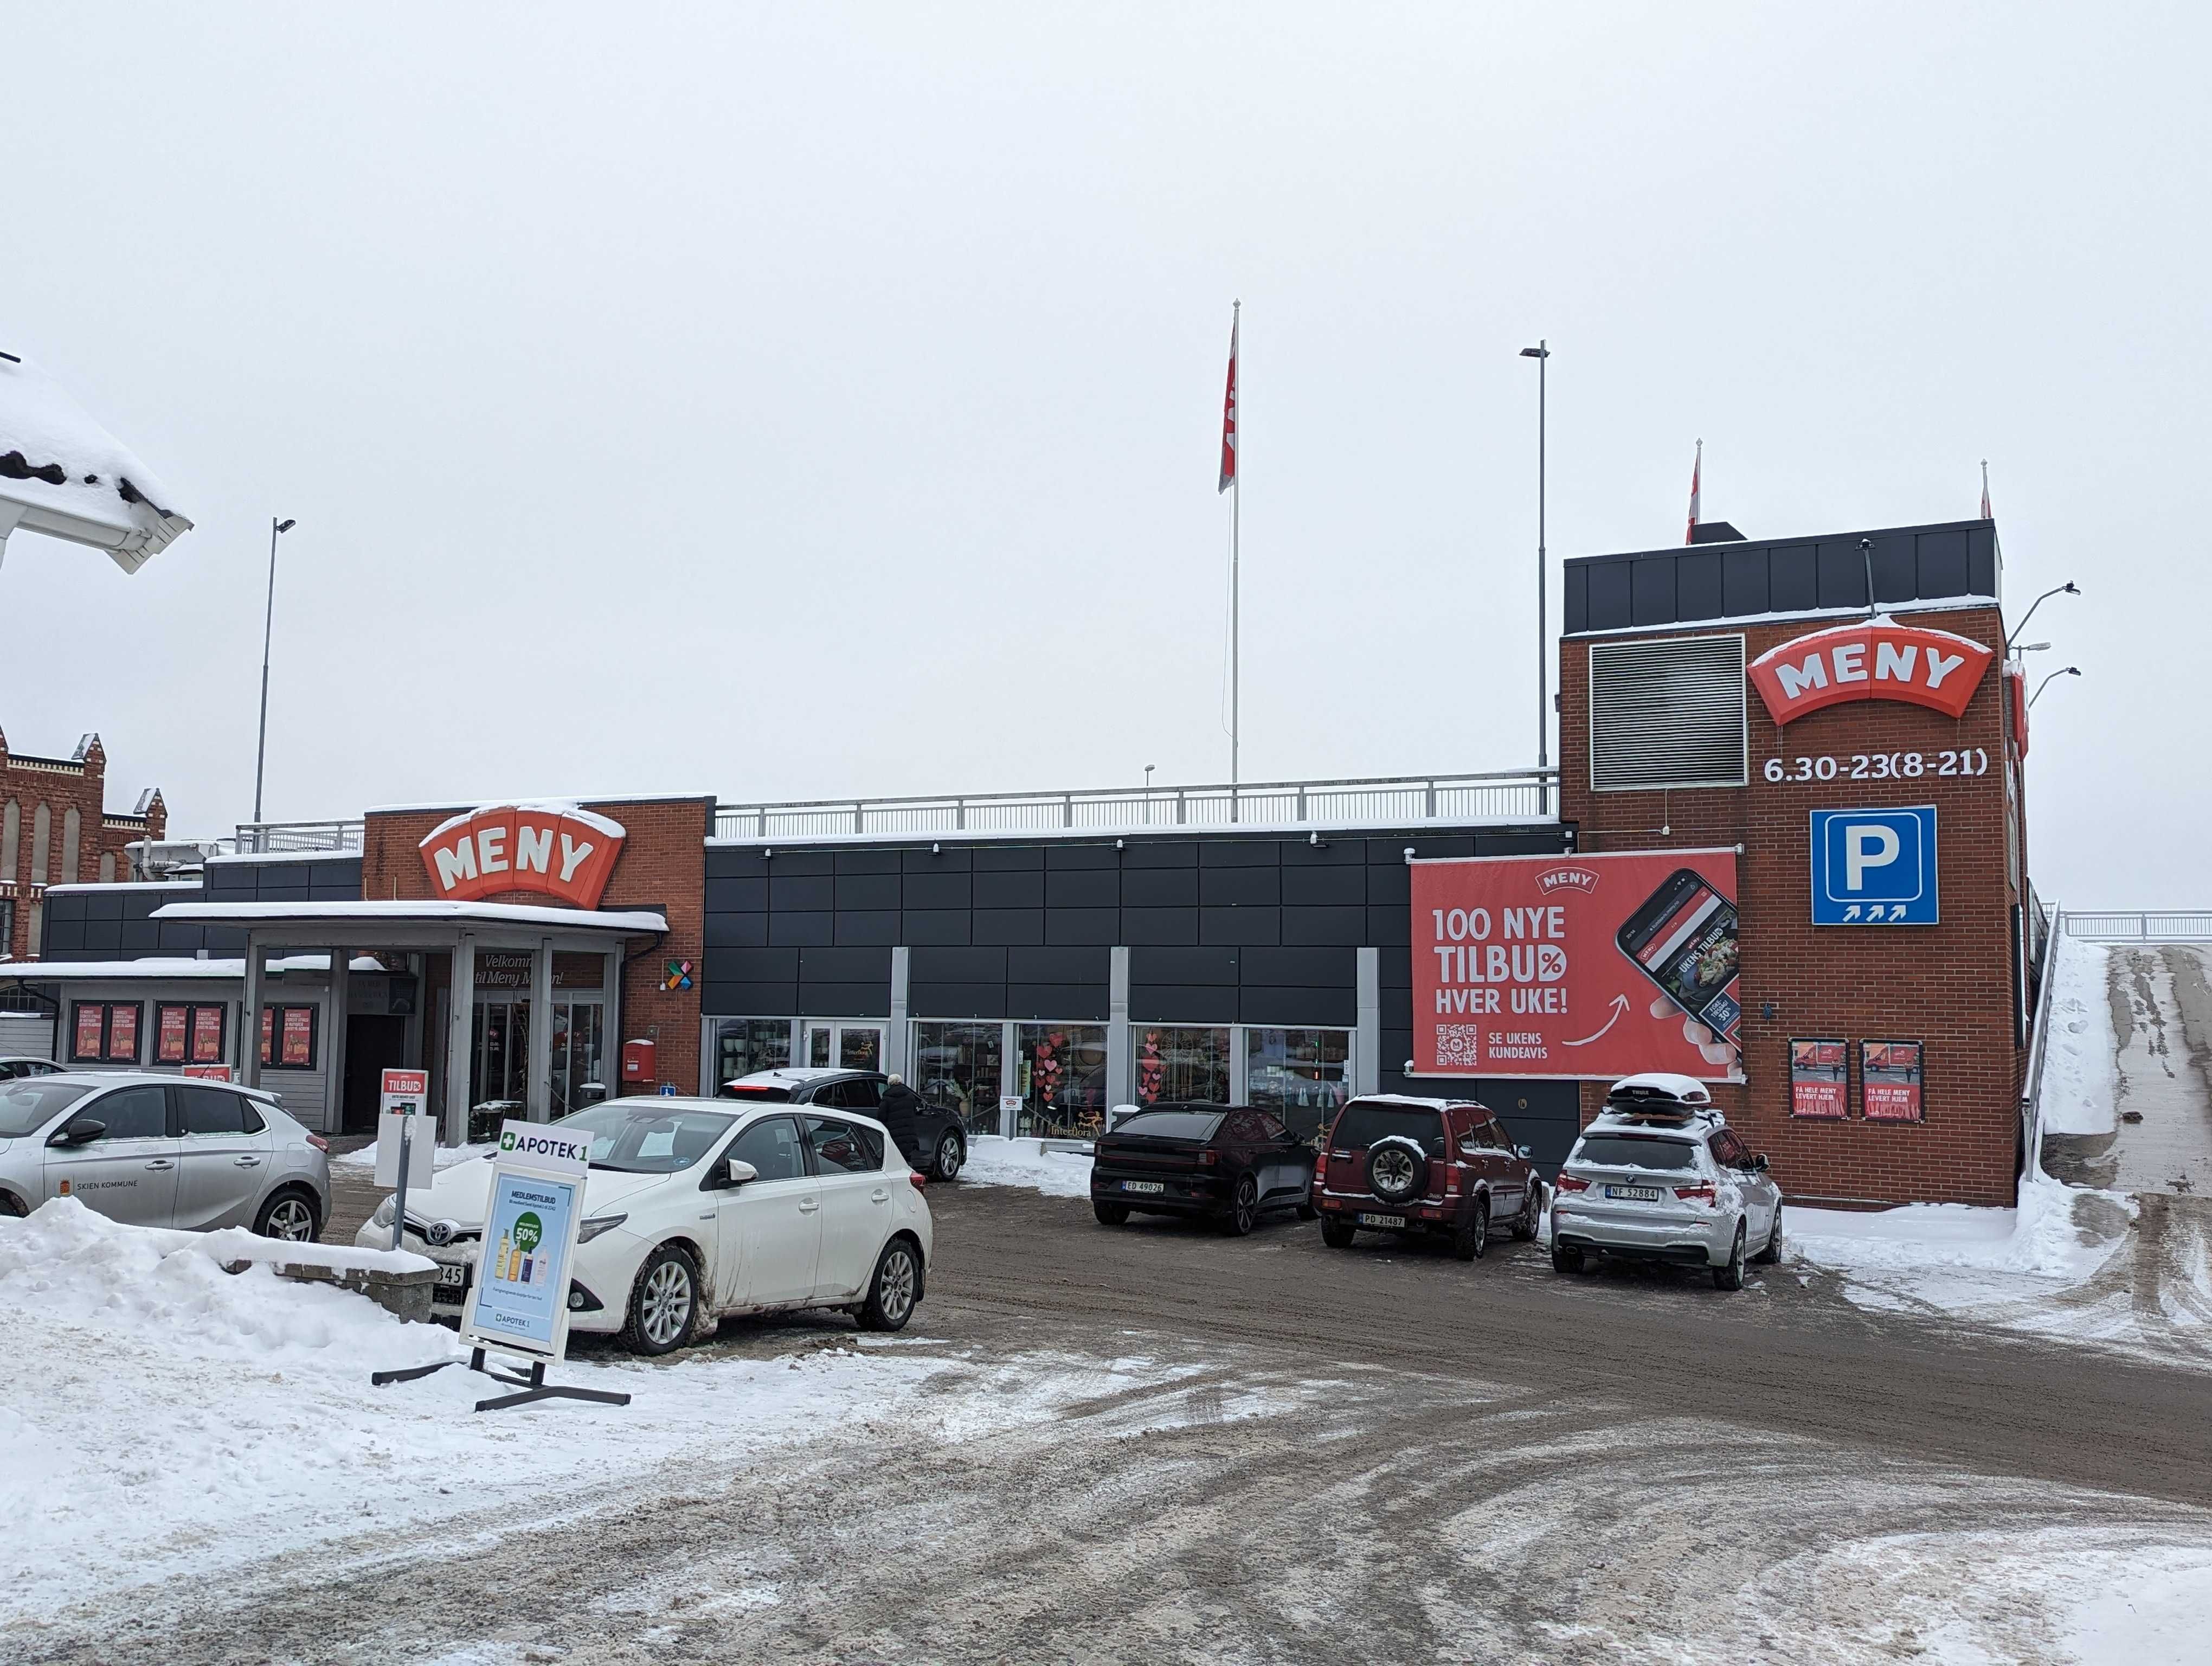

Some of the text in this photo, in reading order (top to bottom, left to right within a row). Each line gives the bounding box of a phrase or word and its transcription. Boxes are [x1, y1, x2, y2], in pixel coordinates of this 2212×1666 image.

[1775, 642, 1965, 700] MENY
[1764, 748, 1988, 783] 6.30-23(8-21)
[434, 826, 594, 891] MENY
[1846, 824, 1900, 890] P
[1544, 872, 1592, 888] MENY
[1432, 906, 1565, 941] 100 NYE
[1642, 944, 1656, 959] MENY
[1678, 927, 1724, 973] UKENS TILBUD
[1434, 944, 1567, 983] TILBUD
[475, 971, 486, 984] til
[487, 971, 520, 988] Meny
[1436, 988, 1568, 1014] HVER UKE!
[1488, 1033, 1542, 1045] SE UKENS
[1489, 1047, 1548, 1059] KUNDEAVIS
[388, 1080, 421, 1092] TILBUD
[1051, 1125, 1092, 1137] Interflora
[516, 1136, 588, 1162] APOTEK 1
[101, 1180, 138, 1188] KOMMUNE
[1139, 1183, 1162, 1191] 49026
[511, 1190, 556, 1204] MEDLEMSTILBUD
[1612, 1187, 1655, 1199] NF 52884
[1365, 1215, 1403, 1226] PD 21487
[516, 1227, 538, 1242] 50%
[501, 1315, 526, 1327] APOTEK
